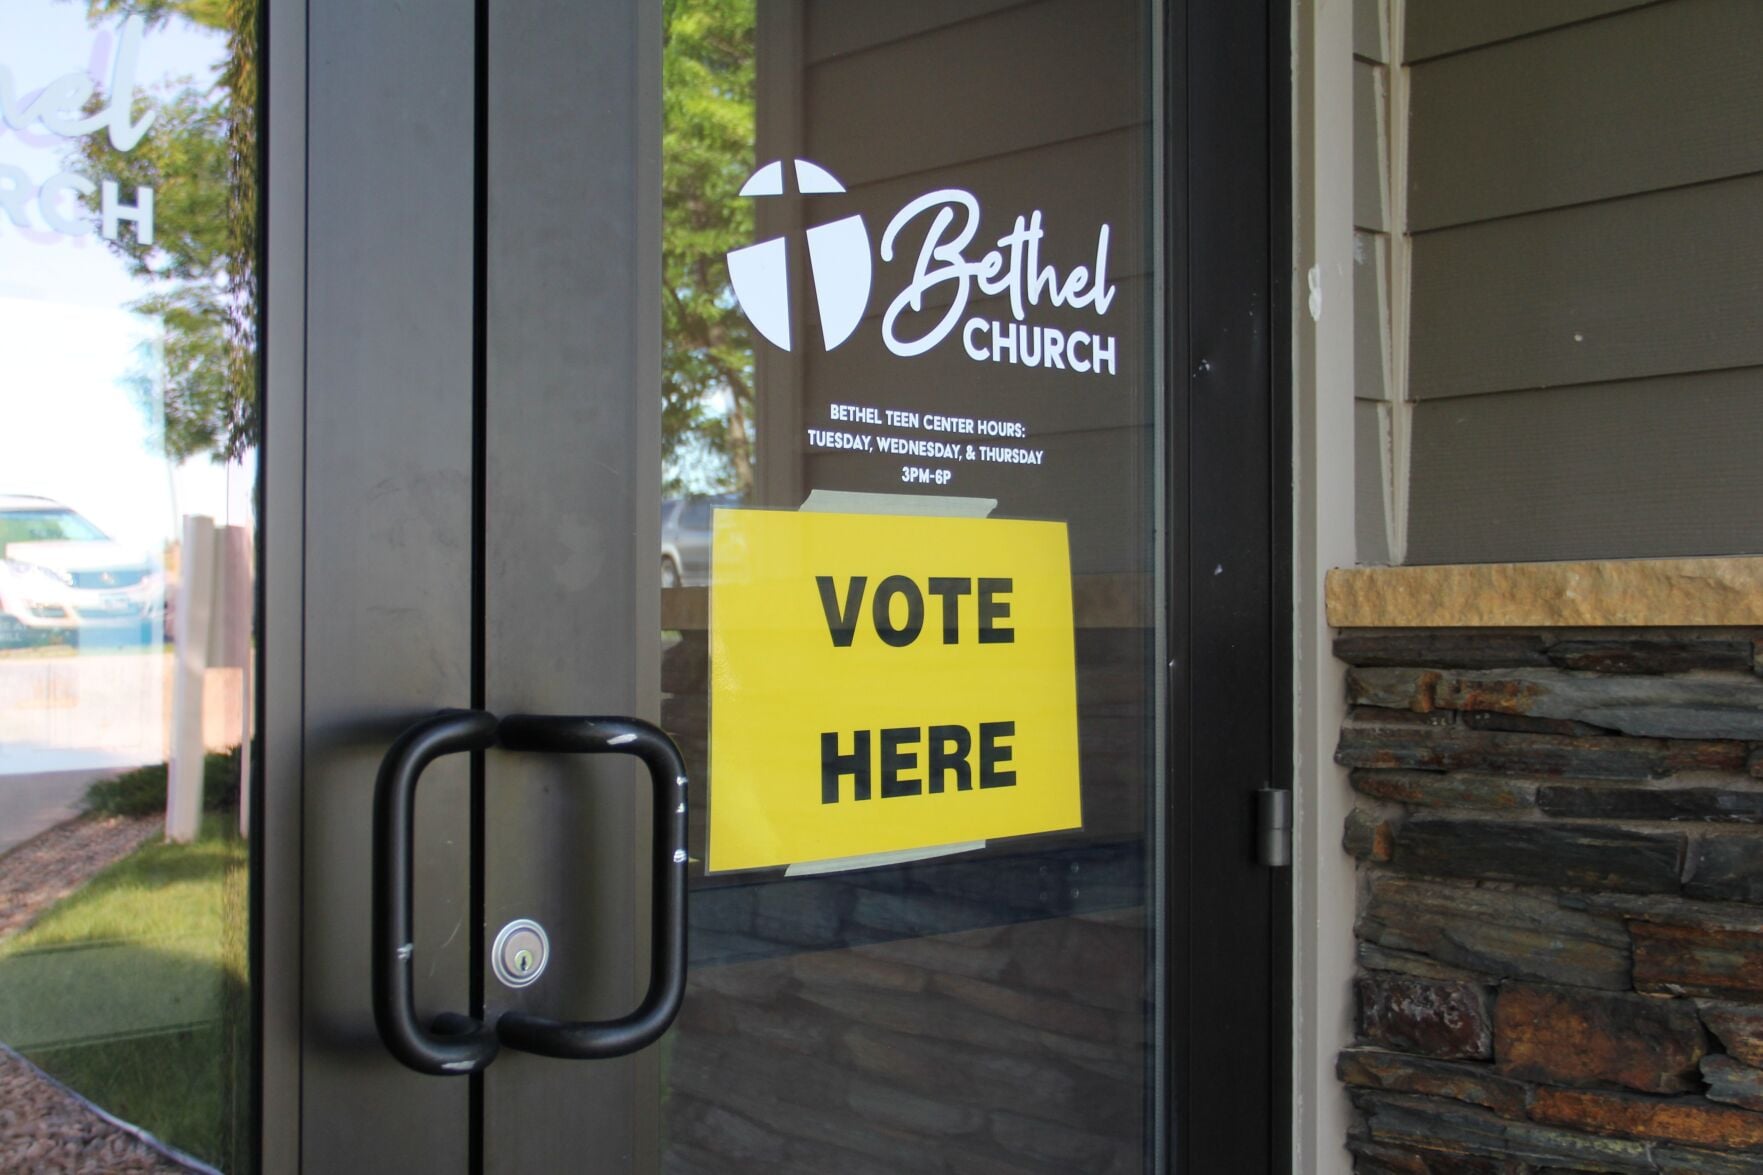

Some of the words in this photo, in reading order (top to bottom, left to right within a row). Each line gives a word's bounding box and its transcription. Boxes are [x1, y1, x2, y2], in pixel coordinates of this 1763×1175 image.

[880, 189, 1116, 357] Bethel
[963, 317, 1116, 375] CHURCH
[807, 429, 873, 454] TUESDAY,
[876, 436, 963, 462] WEDNESDAY,
[966, 444, 976, 461] &
[979, 446, 1043, 465] THURSDAY
[830, 403, 882, 425] BETHEL
[886, 410, 919, 428] TEEN
[923, 414, 974, 434] CENTER
[977, 419, 1026, 438] HOURS:
[901, 466, 952, 485] 3PM-6P
[815, 574, 1015, 648] VOTE
[820, 720, 1017, 805] HERE
